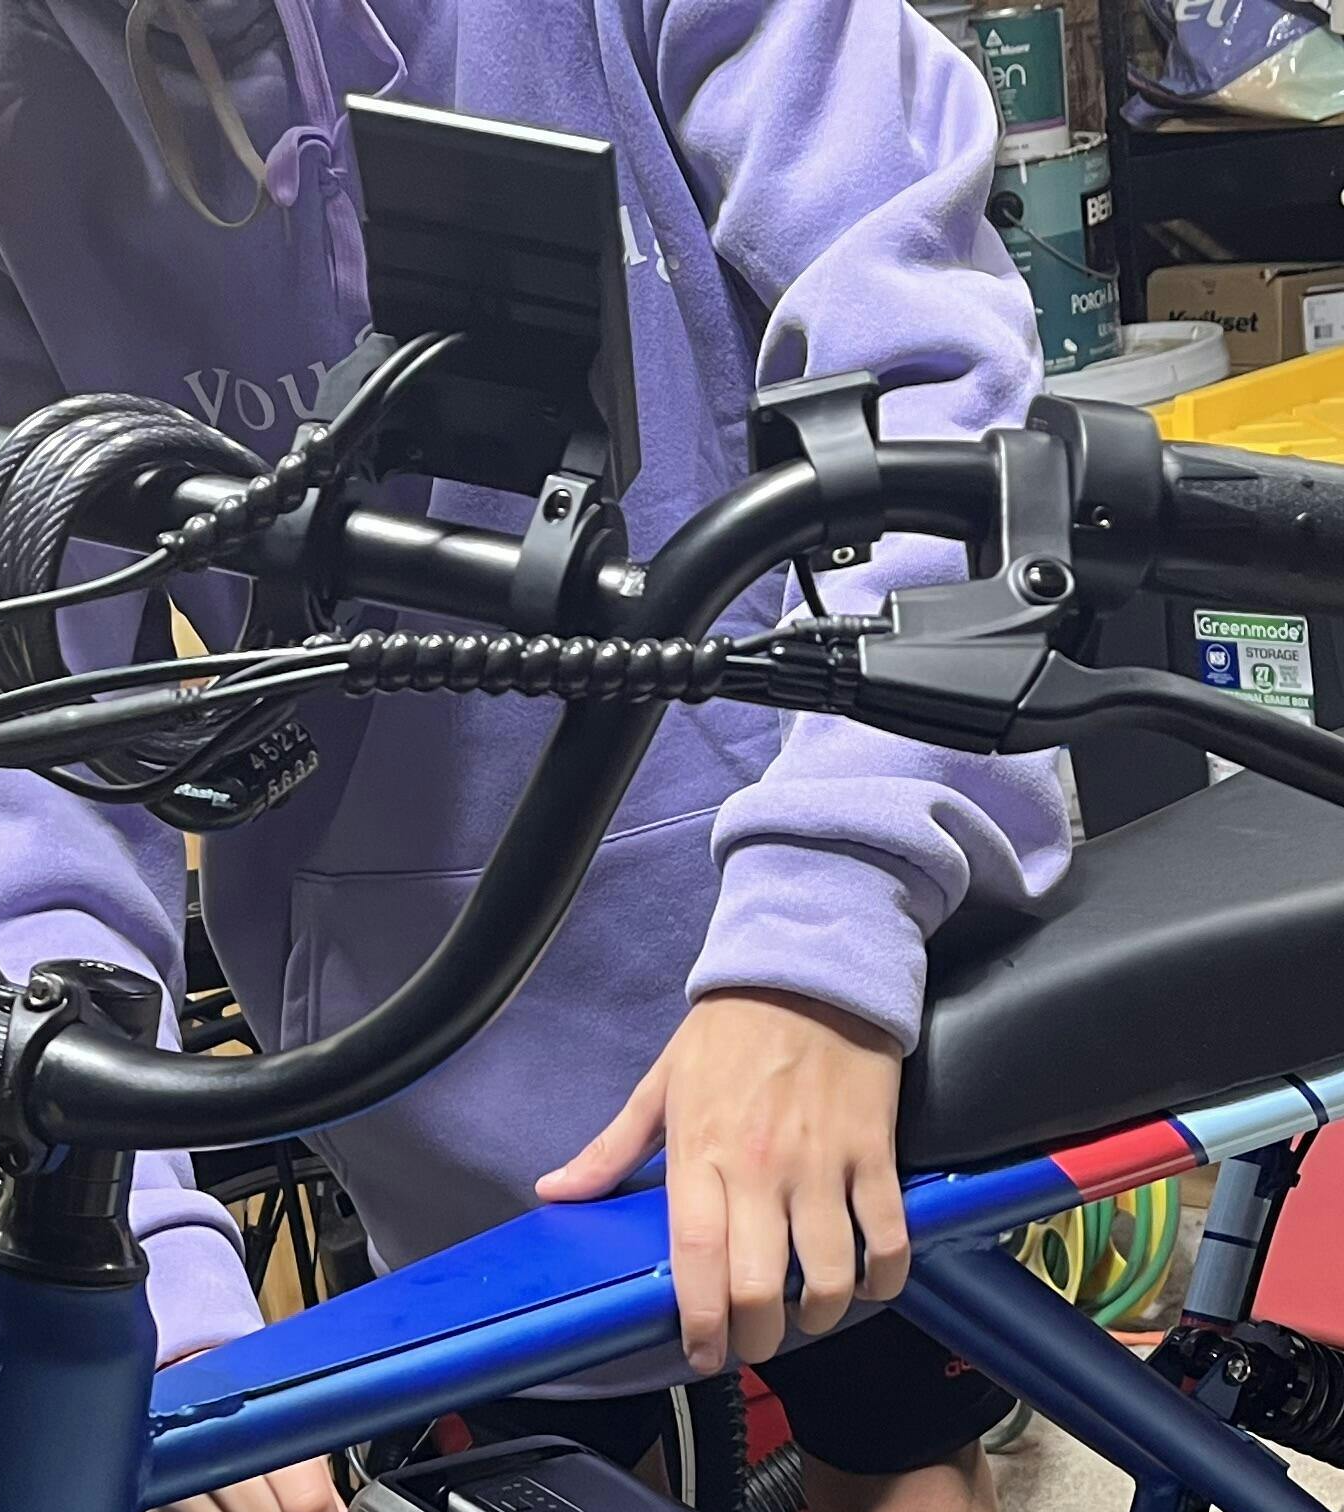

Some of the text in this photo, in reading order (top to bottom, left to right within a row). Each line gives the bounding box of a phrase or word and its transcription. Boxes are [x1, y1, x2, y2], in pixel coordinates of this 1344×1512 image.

[1199, 616, 1301, 641] Greenmade
[1246, 646, 1299, 661] STORAGE
[1255, 666, 1269, 682] 27
